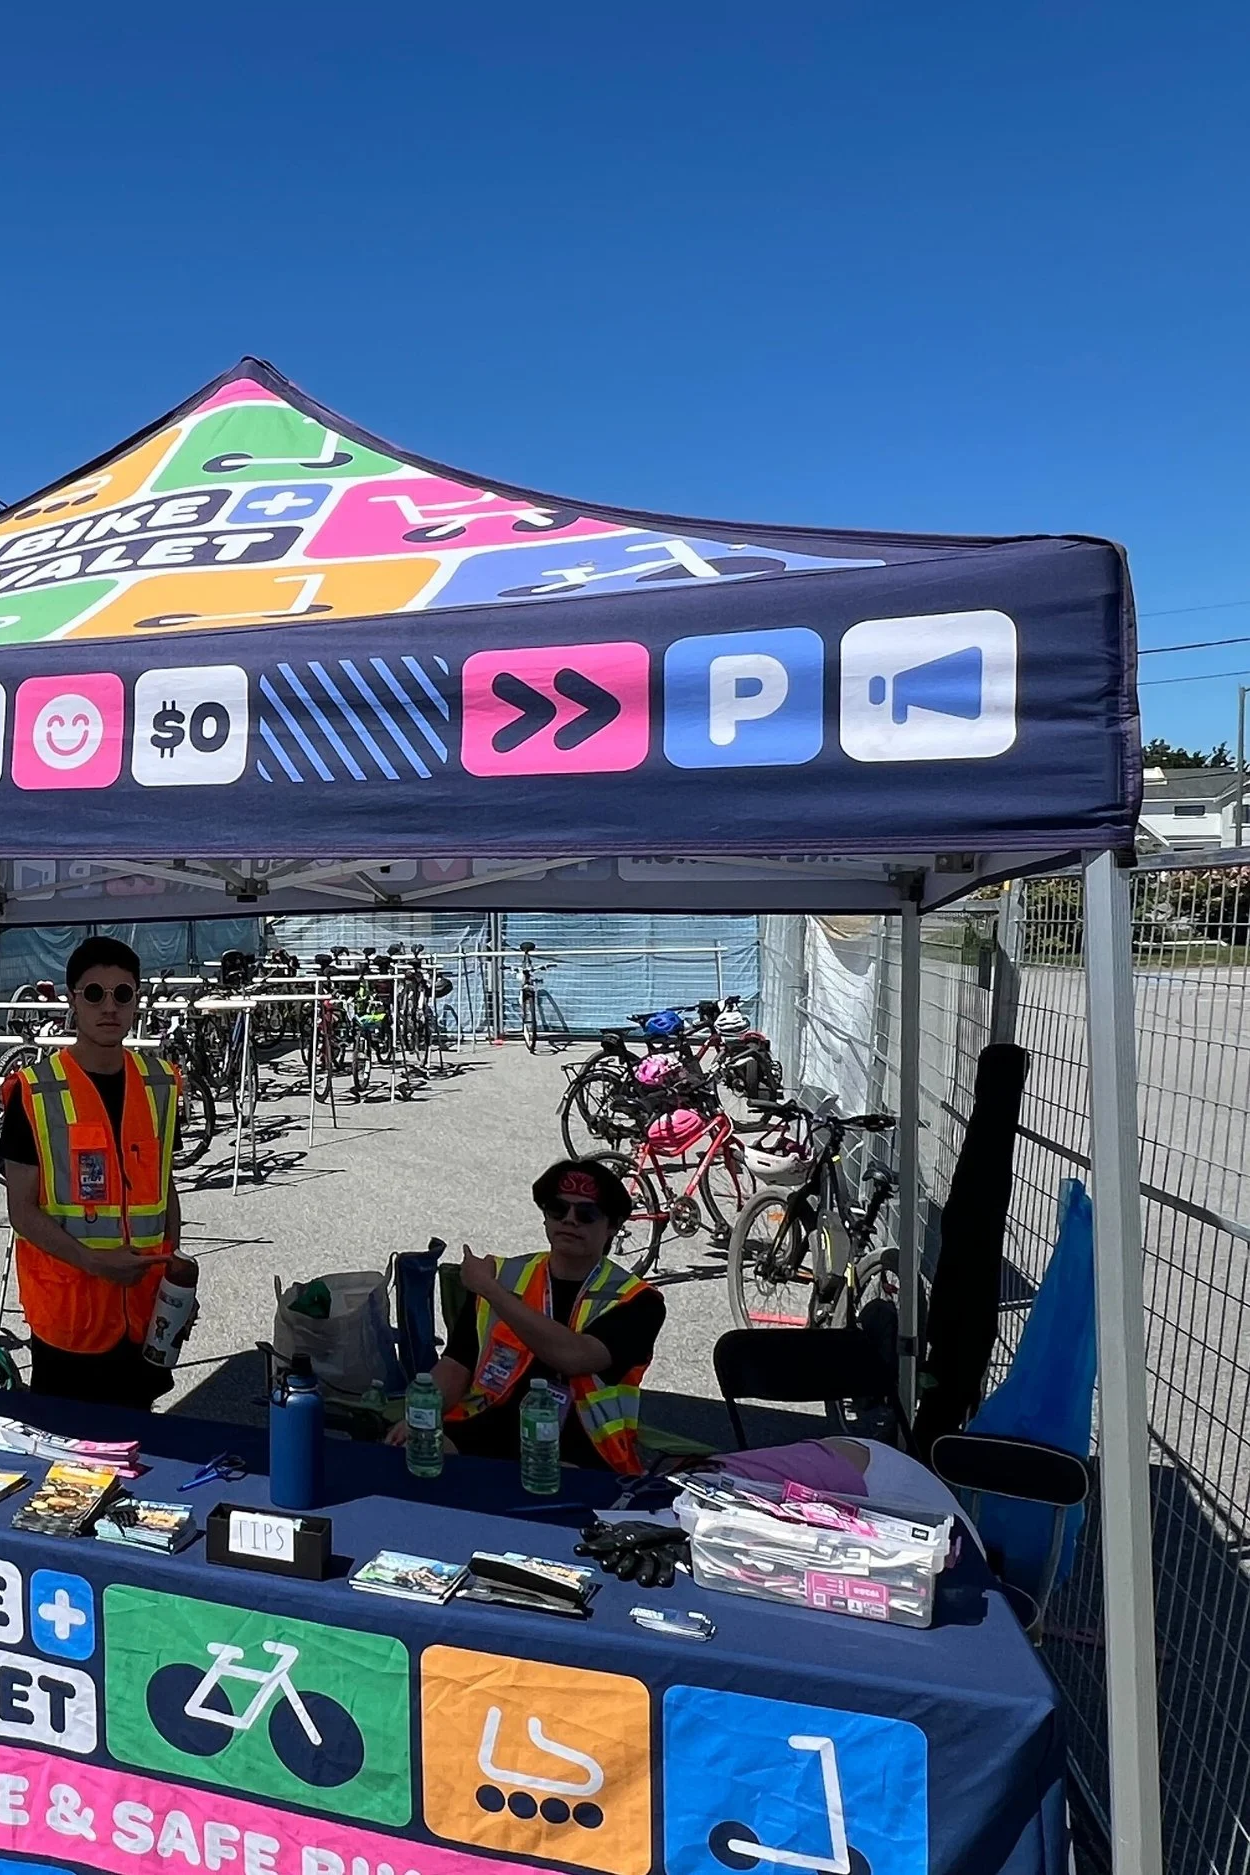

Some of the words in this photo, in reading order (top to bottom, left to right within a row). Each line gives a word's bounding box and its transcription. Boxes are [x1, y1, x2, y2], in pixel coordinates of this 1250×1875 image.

[0, 495, 211, 561] BIKE
[151, 701, 229, 758] $0
[709, 655, 788, 745] P
[238, 1519, 285, 1552] TIPS
[46, 1784, 97, 1840] &
[112, 1801, 280, 1875] SAFE
